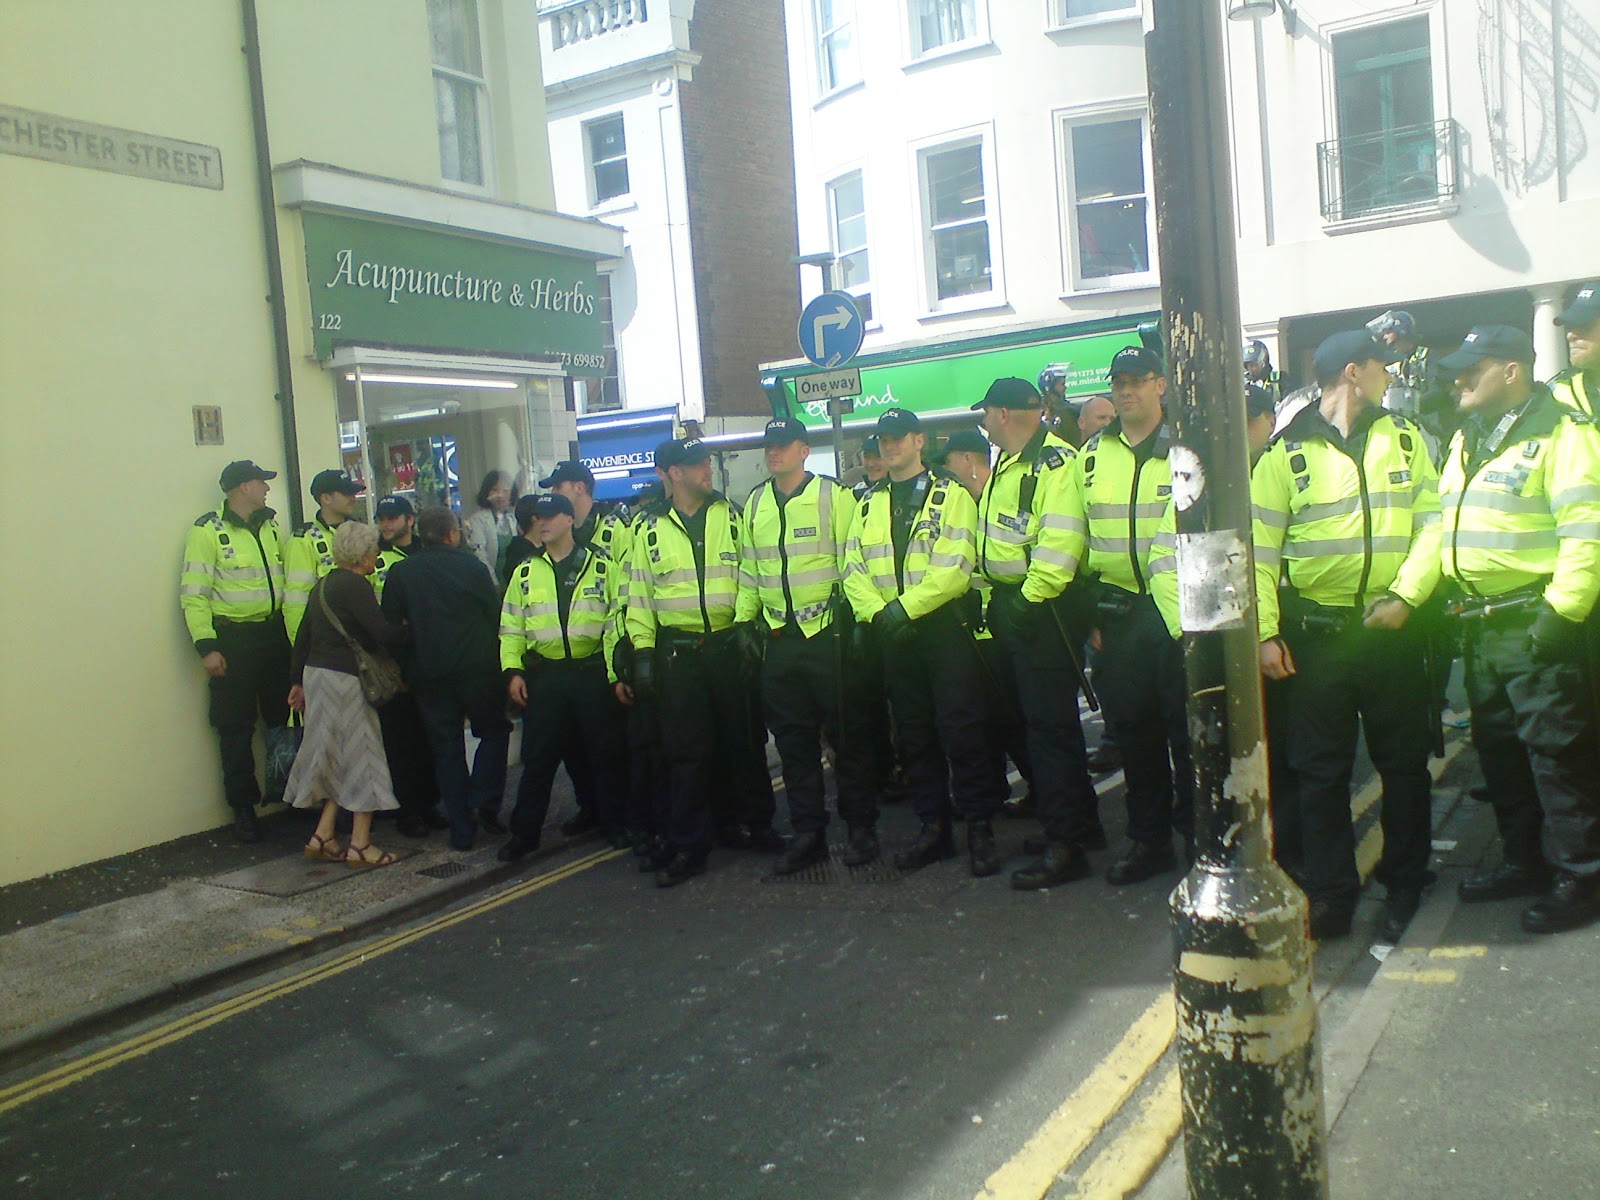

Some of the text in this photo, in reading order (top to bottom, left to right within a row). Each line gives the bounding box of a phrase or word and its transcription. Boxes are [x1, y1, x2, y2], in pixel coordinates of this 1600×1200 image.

[127, 141, 212, 177] STREET
[327, 249, 595, 316] Acupuncture & Herbs
[319, 313, 342, 331] 122
[573, 353, 606, 369] 699852
[801, 377, 855, 394] One way
[794, 527, 816, 537] POLICE
